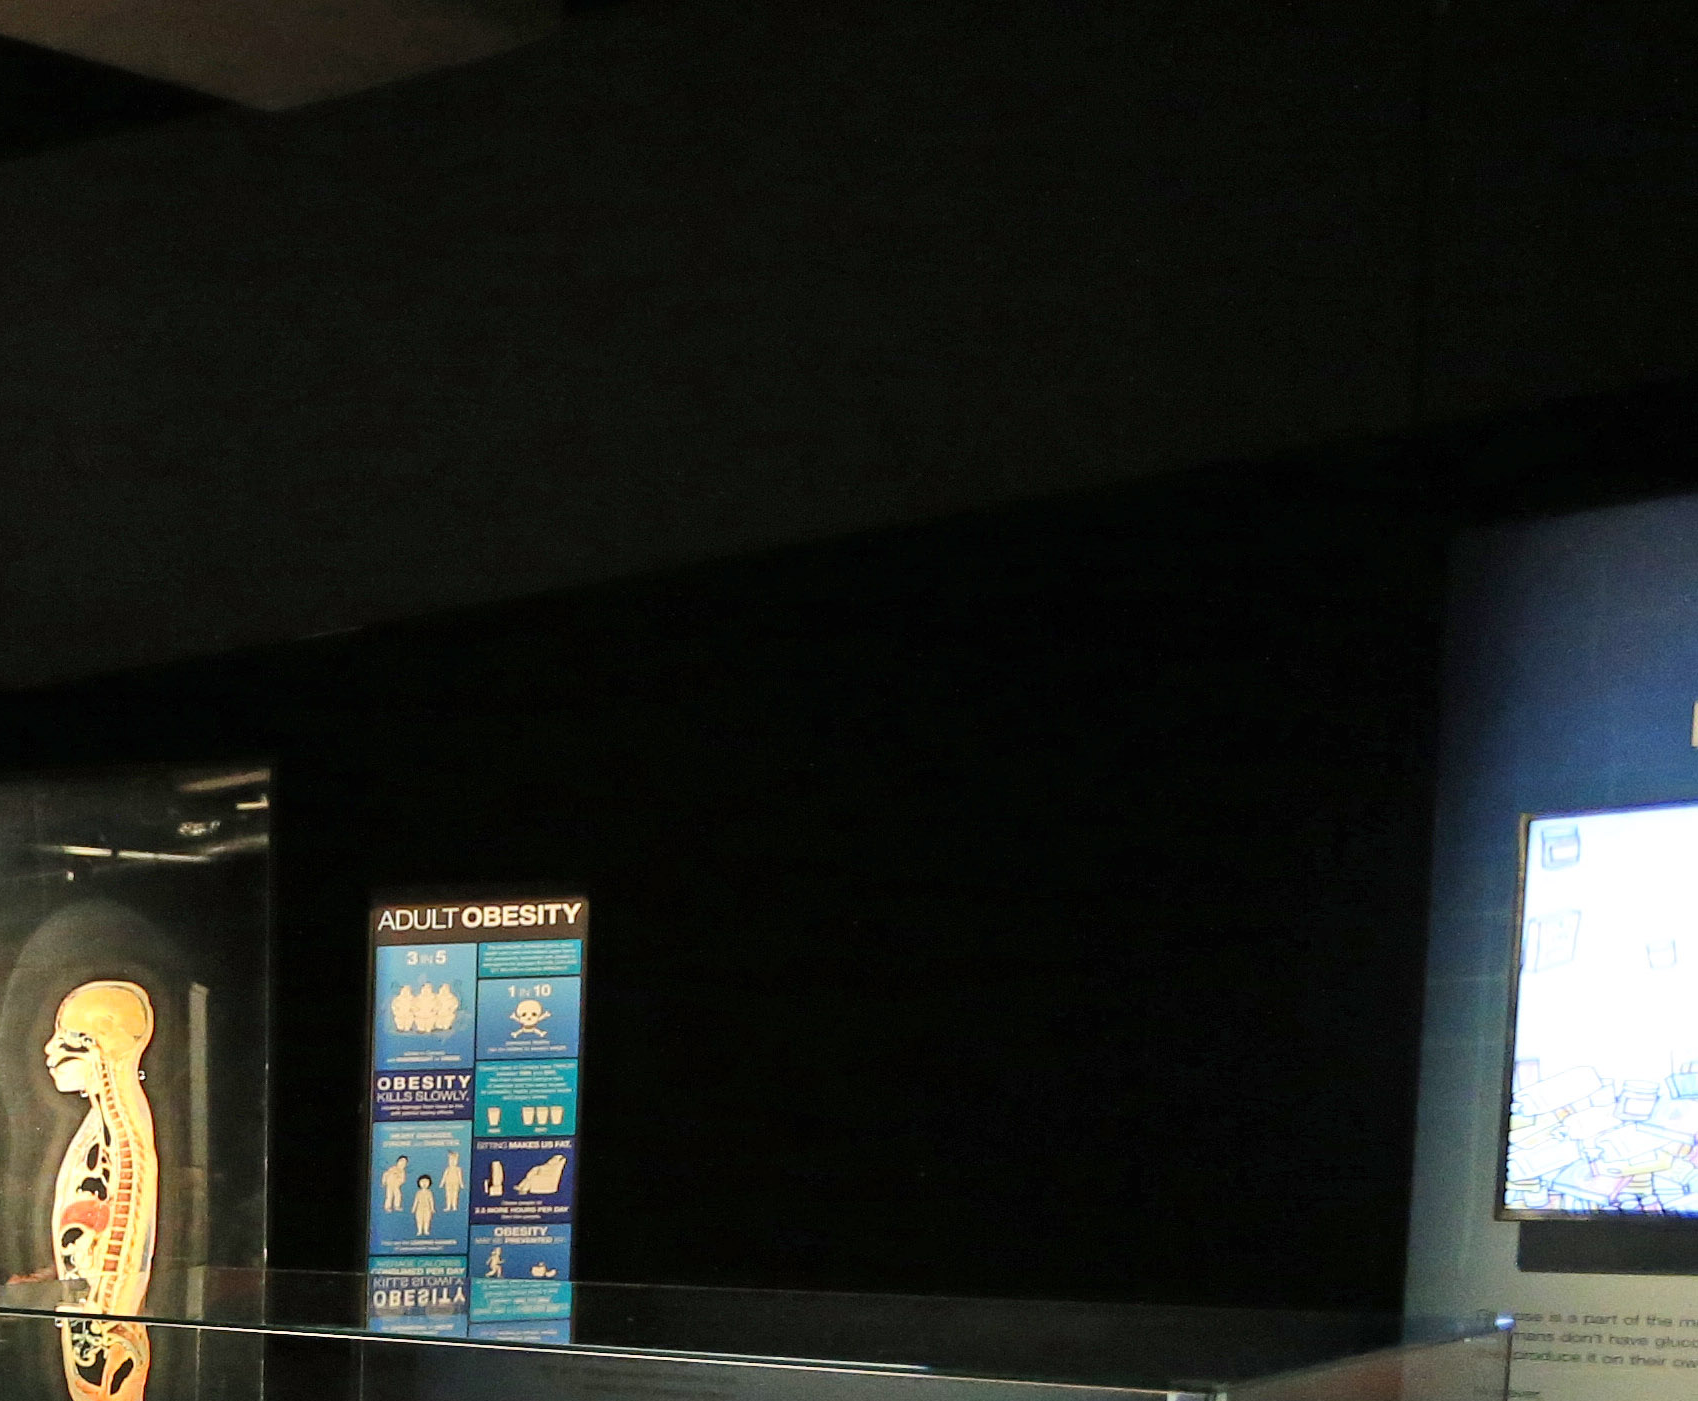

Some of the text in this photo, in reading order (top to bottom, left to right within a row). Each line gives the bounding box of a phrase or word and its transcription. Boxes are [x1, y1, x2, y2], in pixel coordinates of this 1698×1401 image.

[377, 902, 582, 931] ADULT OBESITY
[407, 950, 419, 965] 3
[435, 950, 447, 965] 5
[508, 985, 515, 997] 1
[533, 984, 552, 997] 10
[377, 1075, 472, 1091] OBESITY
[376, 1090, 470, 1103] KILLS SLOWLY.
[508, 1141, 540, 1149] MAKES
[493, 1226, 548, 1237] OBESITY
[1583, 1313, 1617, 1325] part
[1646, 1315, 1673, 1328] the
[1609, 1333, 1650, 1347] have
[1630, 1354, 1665, 1367] their
